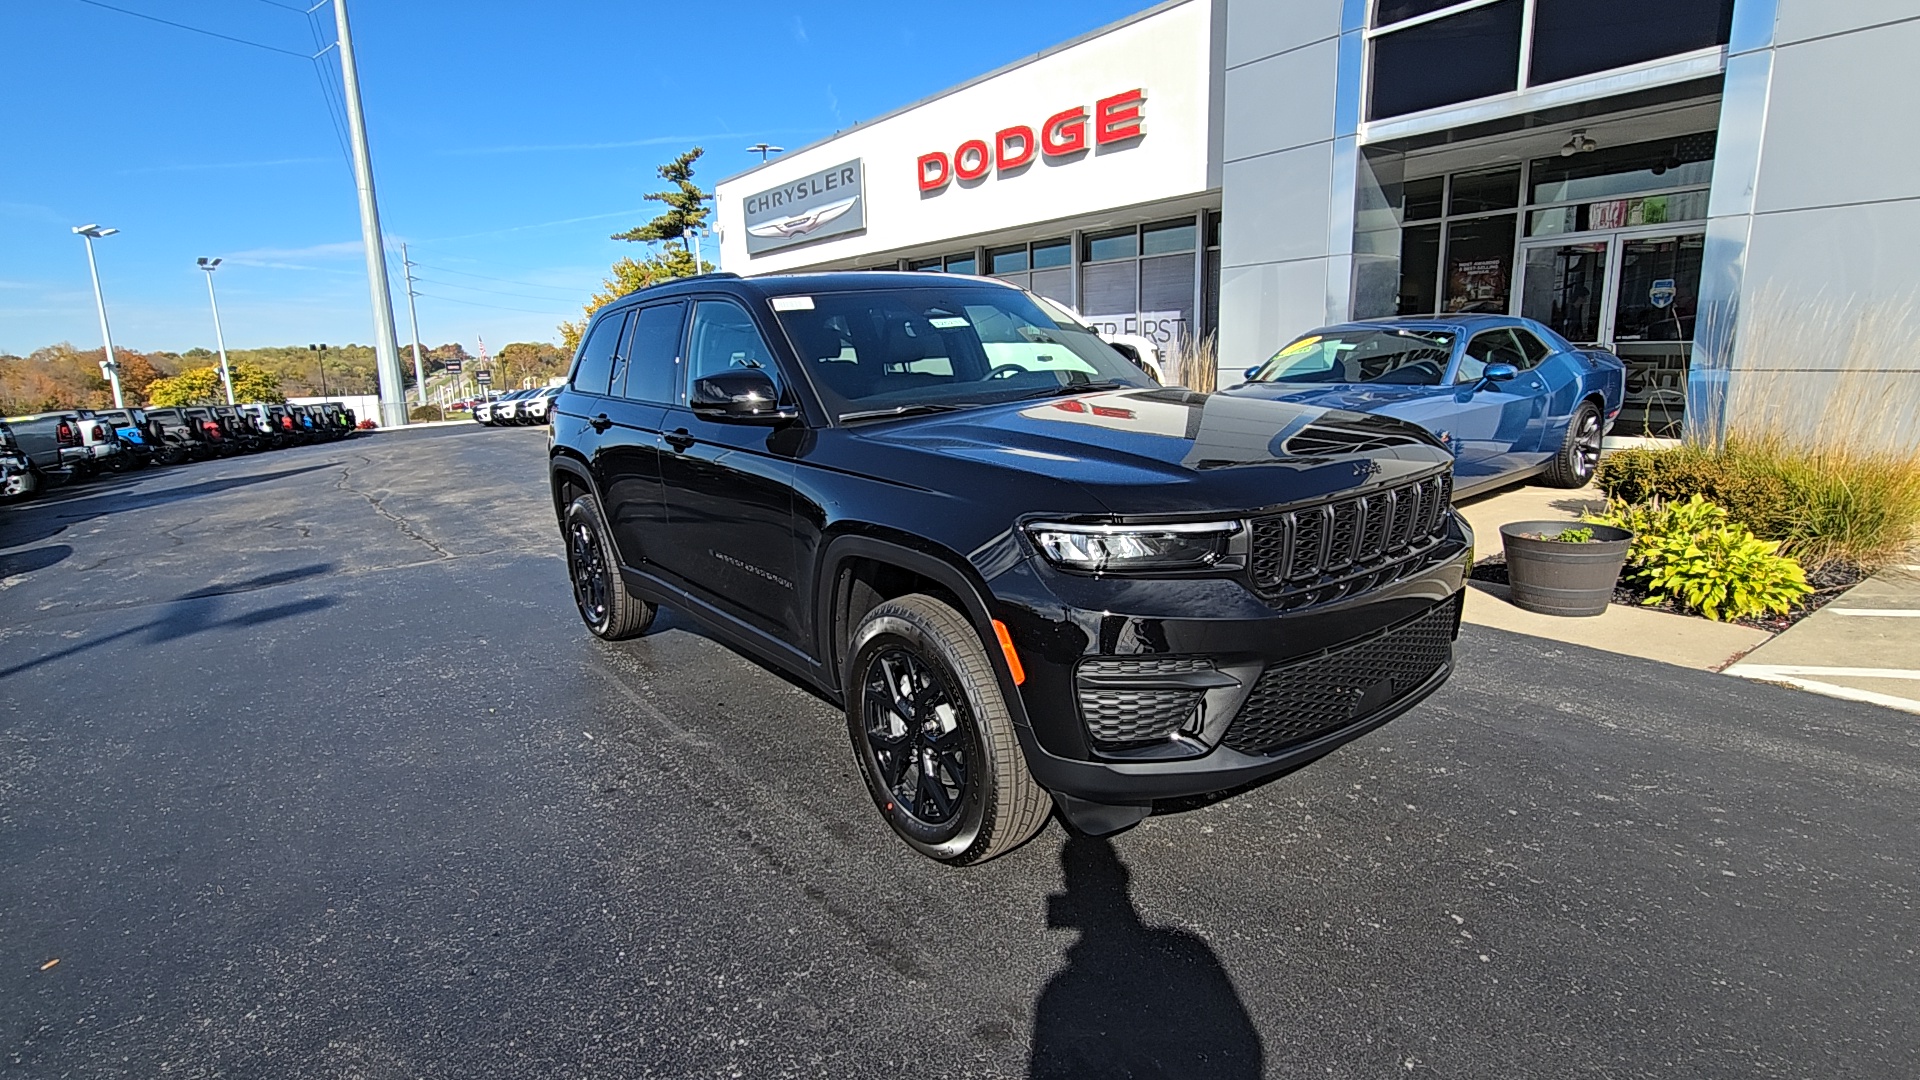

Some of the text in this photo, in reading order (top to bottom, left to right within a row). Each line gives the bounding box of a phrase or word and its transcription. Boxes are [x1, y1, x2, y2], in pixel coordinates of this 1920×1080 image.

[917, 88, 1147, 191] DODGE
[747, 167, 855, 215] CHRYSLER
[1124, 317, 1186, 343] FIRST
